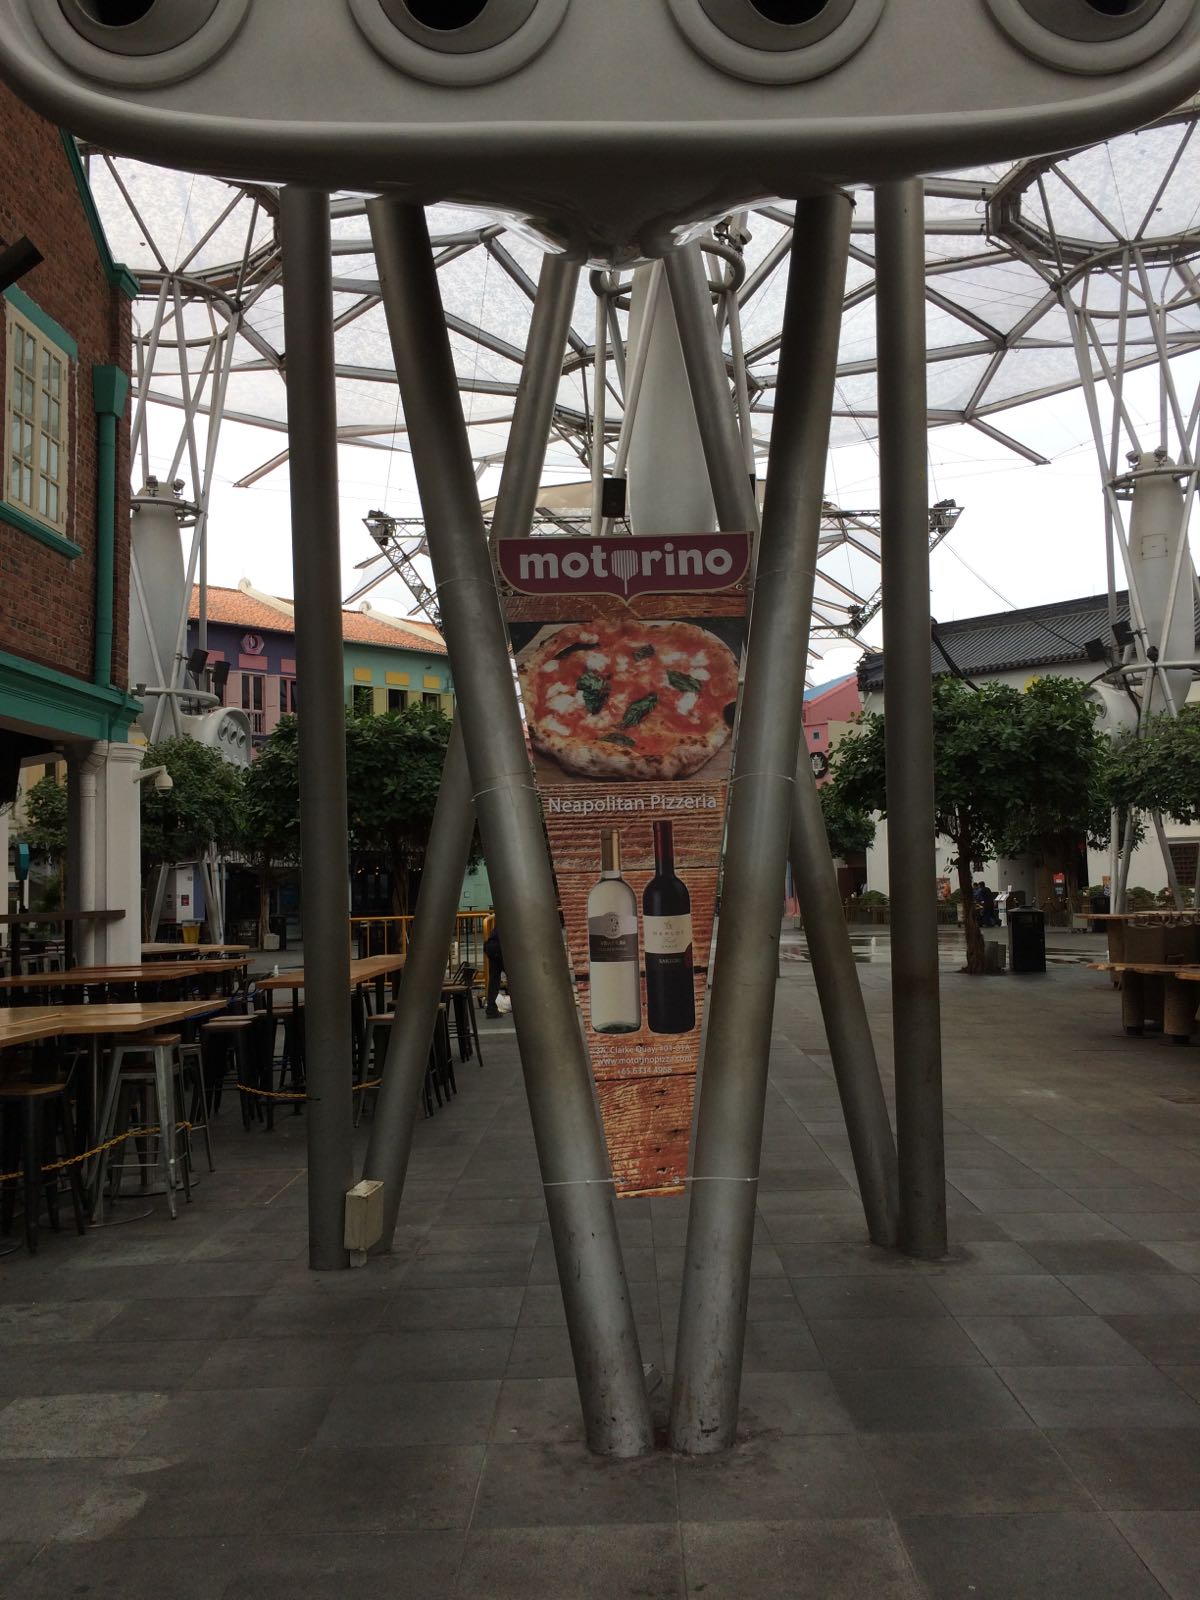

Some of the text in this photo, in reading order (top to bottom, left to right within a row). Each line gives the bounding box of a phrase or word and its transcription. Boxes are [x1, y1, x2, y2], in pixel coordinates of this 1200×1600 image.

[519, 542, 733, 580] motorino
[548, 793, 717, 815] Neapolitan Pizzeria
[610, 1045, 634, 1054] Clarke
